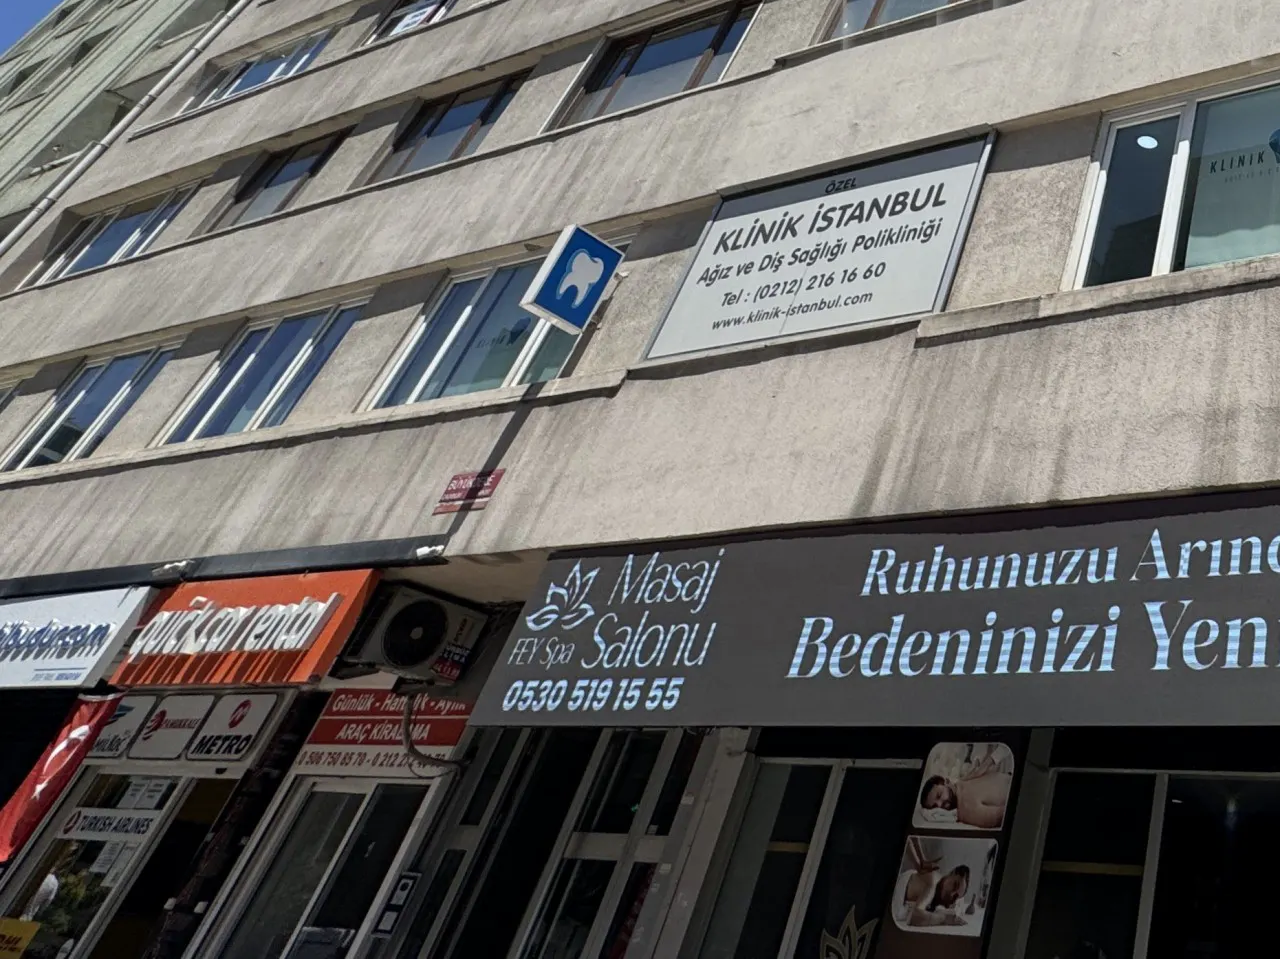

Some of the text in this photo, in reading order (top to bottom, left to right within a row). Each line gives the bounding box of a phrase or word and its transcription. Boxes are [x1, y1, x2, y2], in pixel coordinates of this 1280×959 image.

[825, 177, 857, 194] ÖZEL
[713, 183, 947, 255] KLİNİK İSTANBUL
[697, 217, 943, 287] Ağız ve Diş Sağlığı Polikliniği
[721, 289, 744, 307] Tel
[753, 277, 803, 304] (0212)
[805, 272, 835, 291] 216
[840, 267, 858, 285] 16
[863, 261, 887, 280] 60
[712, 292, 873, 330] www.klinik-istanbul.com
[607, 548, 725, 614] Masaj
[860, 542, 1120, 597] Ruhunuzu
[231, 591, 341, 652] rental
[580, 610, 717, 669] Salonu
[785, 605, 1123, 680] Bedeninizi
[508, 637, 543, 665] FEY
[540, 637, 575, 670] Spa
[333, 694, 375, 712] Günlük
[502, 677, 685, 712] 0530 519 15 55
[192, 734, 253, 755] METRO
[336, 723, 371, 743] ARAÇ
[77, 815, 154, 835] TURKISH AIRLINES
